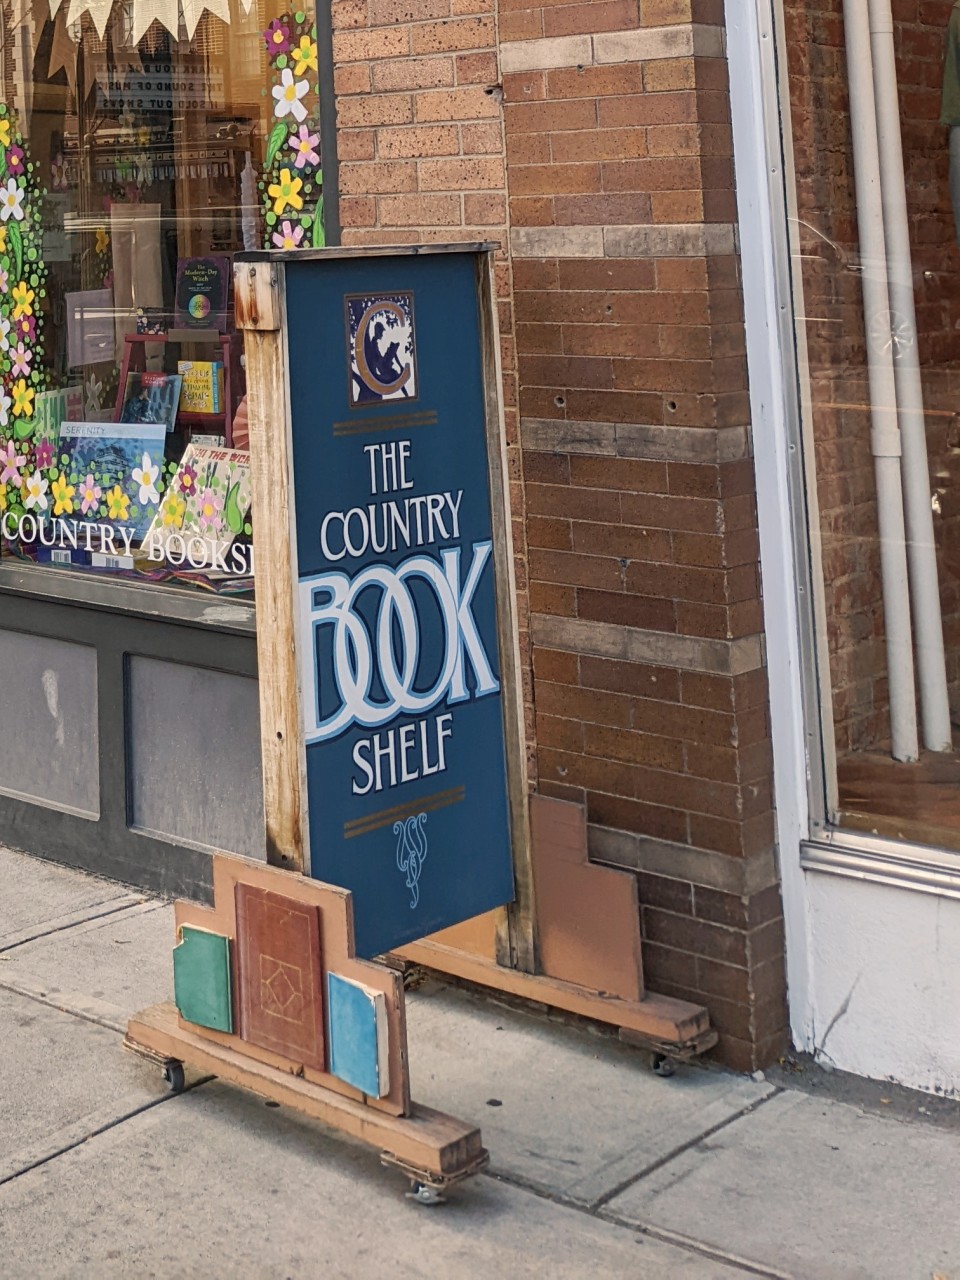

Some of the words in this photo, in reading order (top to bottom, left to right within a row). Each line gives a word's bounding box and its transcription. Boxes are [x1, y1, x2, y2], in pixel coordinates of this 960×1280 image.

[65, 425, 105, 435] SERENITY
[208, 450, 228, 461] THE
[363, 440, 414, 495] THE
[1, 512, 137, 558] COUNTRY
[320, 489, 465, 561] COUNTRY
[298, 540, 500, 745] BOOK
[352, 713, 453, 796] SHELF
